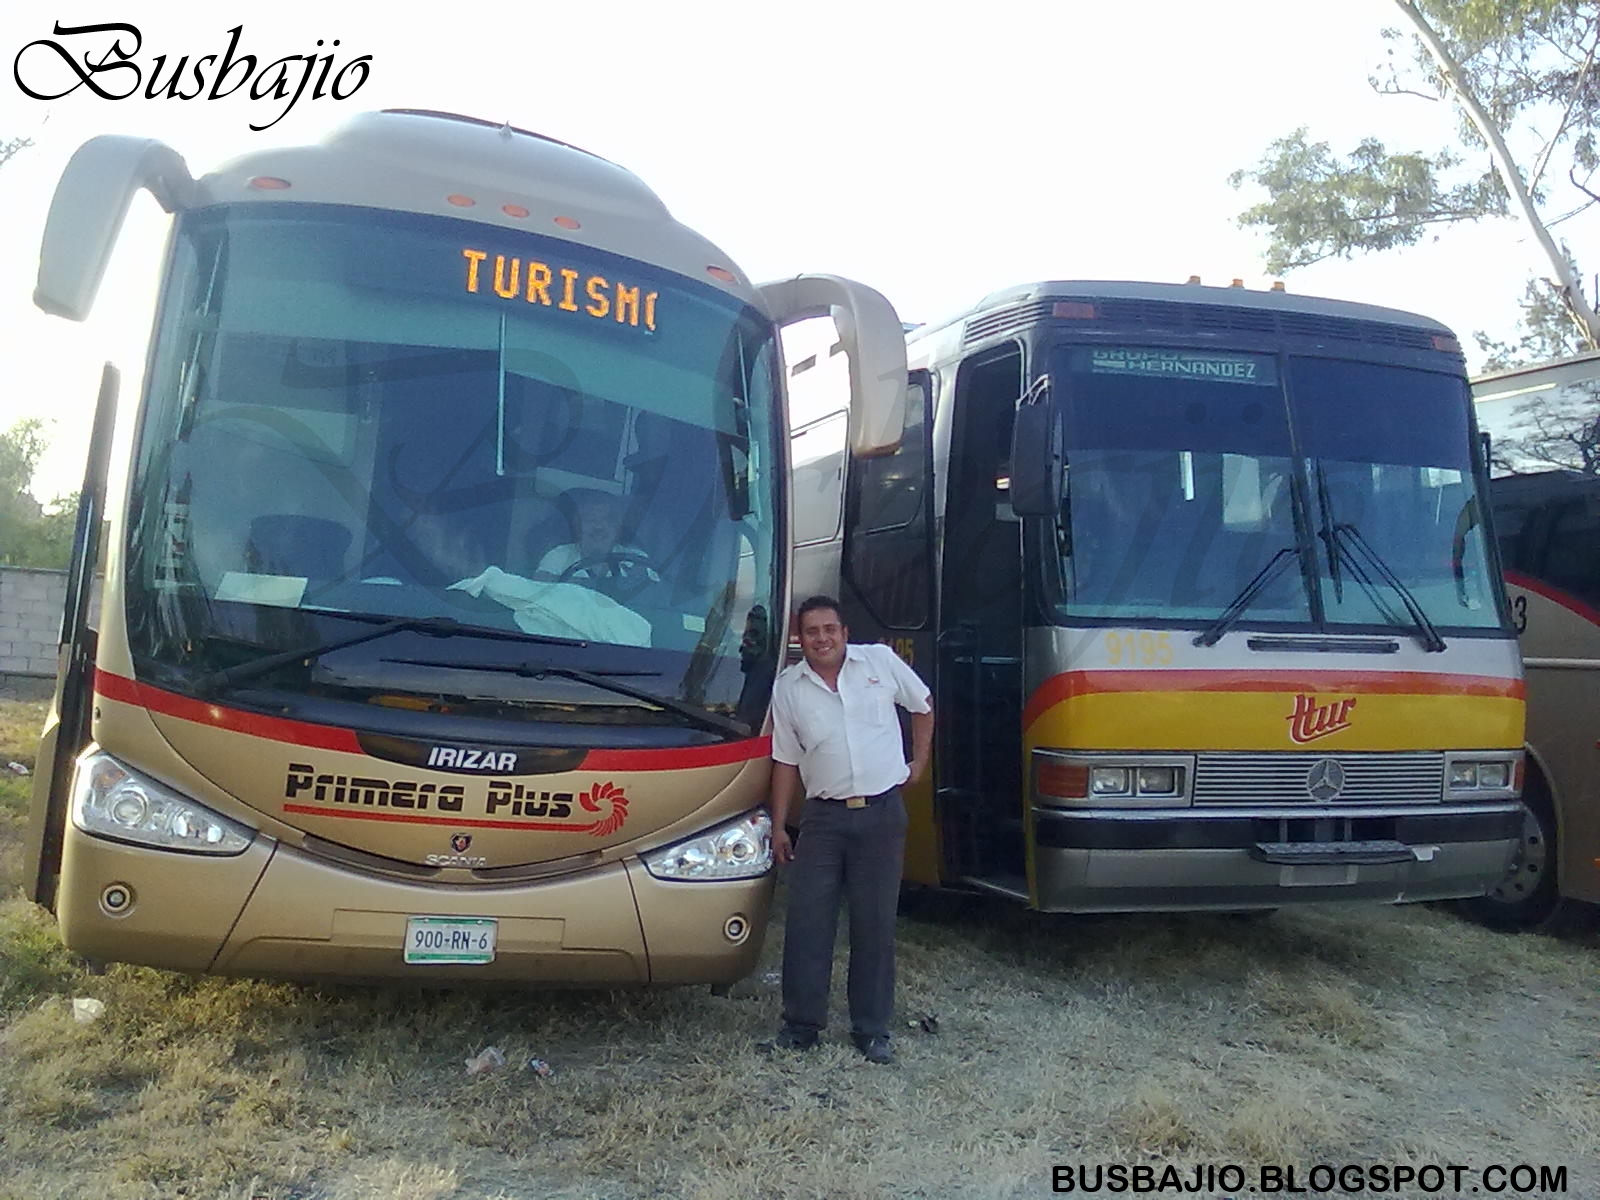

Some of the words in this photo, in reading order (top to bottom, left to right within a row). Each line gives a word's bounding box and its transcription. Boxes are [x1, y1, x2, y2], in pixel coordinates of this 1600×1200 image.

[1129, 360, 1256, 378] HERNANDEZ
[1105, 631, 1174, 666] 9195
[427, 747, 518, 771] IRIZAR
[285, 763, 465, 812] Primera
[486, 780, 574, 819] Plus
[425, 854, 487, 867] SCANIA
[415, 930, 488, 950] 900-RN-6
